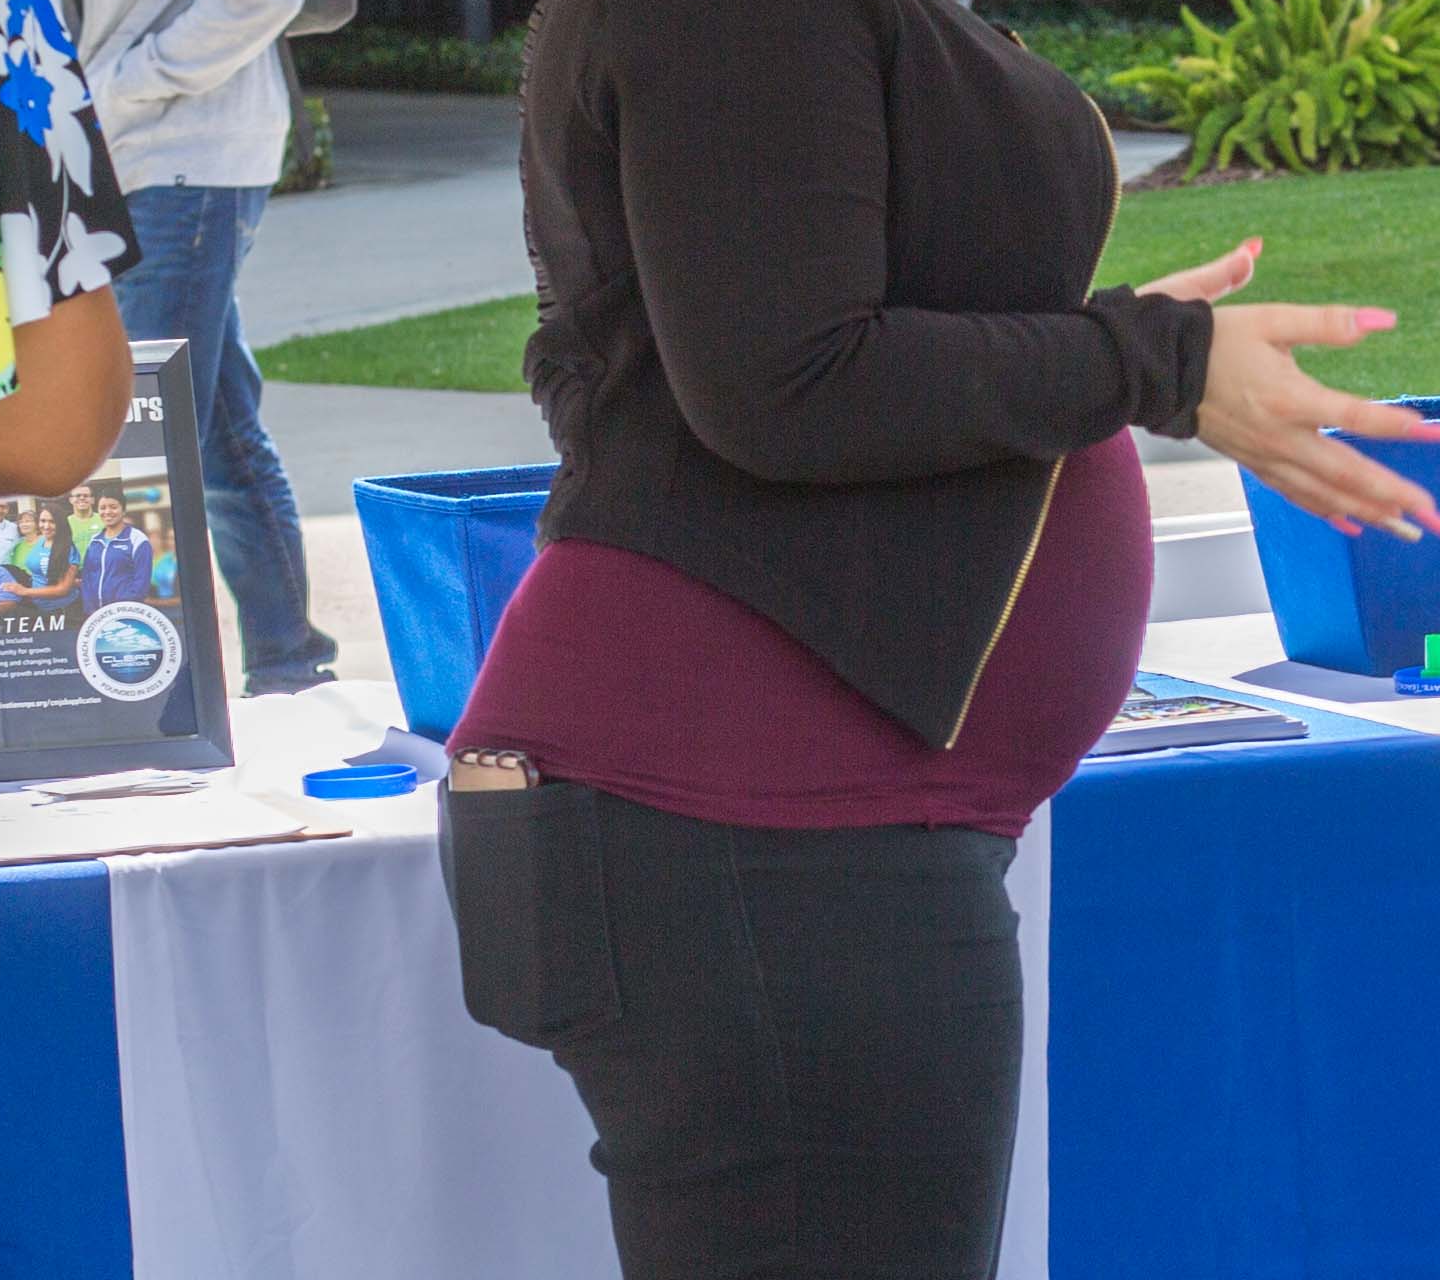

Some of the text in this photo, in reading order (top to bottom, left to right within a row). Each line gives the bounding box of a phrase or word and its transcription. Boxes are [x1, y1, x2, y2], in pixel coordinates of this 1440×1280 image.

[4, 614, 66, 634] TEAM
[81, 641, 91, 667] TEACH
[102, 653, 157, 663] CLEAR
